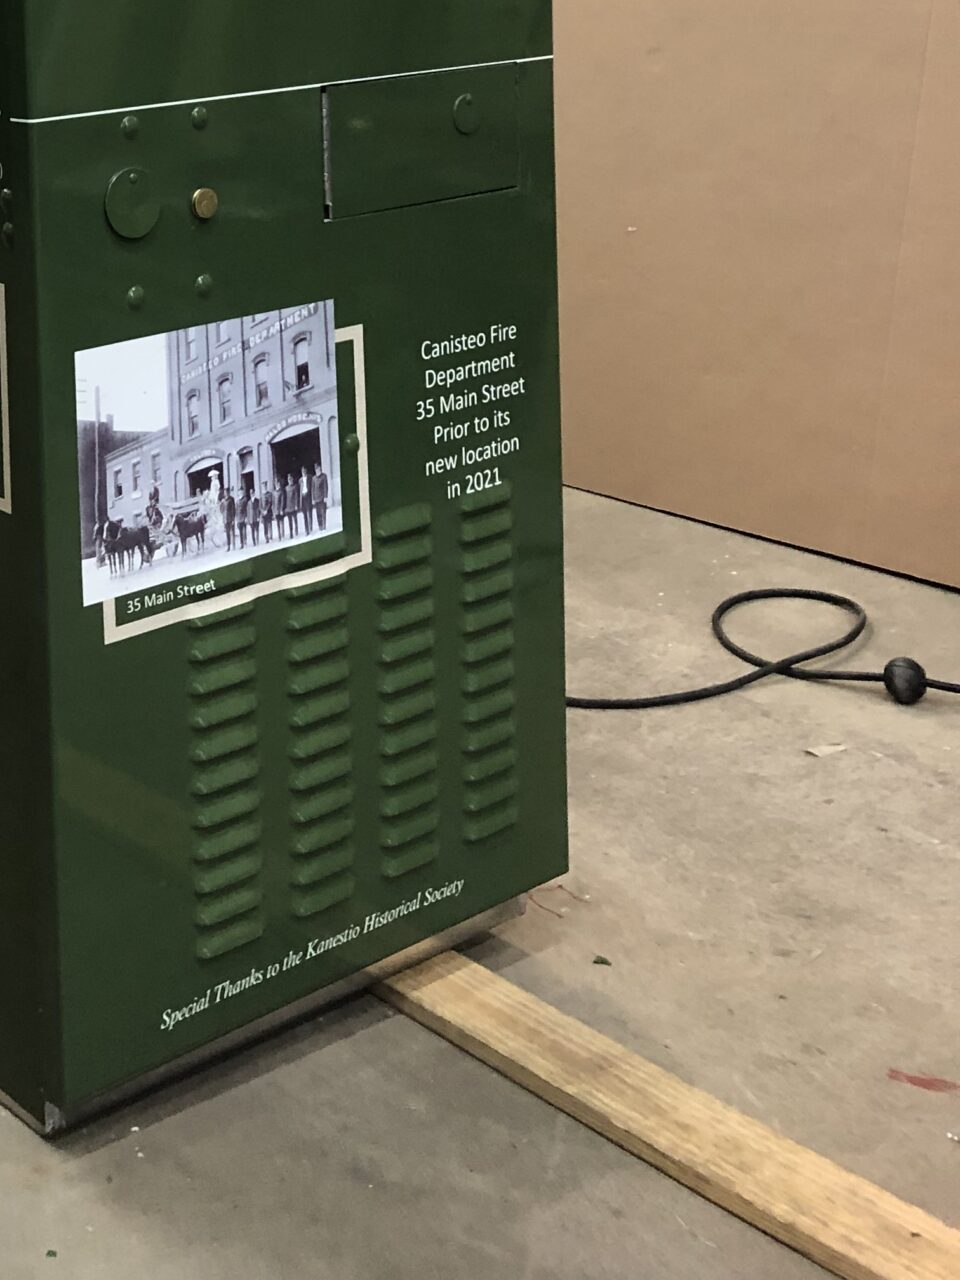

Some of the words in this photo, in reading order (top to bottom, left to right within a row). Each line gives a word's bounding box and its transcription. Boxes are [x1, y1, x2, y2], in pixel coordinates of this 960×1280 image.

[421, 332, 486, 360] Canisteo
[490, 324, 517, 344] Fire
[425, 351, 516, 388] Department
[416, 398, 435, 420] 35
[440, 389, 477, 414] Main
[482, 377, 526, 403] Street
[434, 422, 470, 445] Prior
[474, 416, 490, 434] to
[493, 410, 511, 429] its
[426, 454, 458, 477] new
[461, 437, 520, 467] location
[447, 481, 461, 500] in
[465, 467, 503, 495] 2021
[126, 597, 141, 614] 35
[144, 590, 174, 609] Main
[176, 578, 217, 599] Street
[160, 990, 211, 1031] Special
[214, 968, 264, 1004] Thanks
[266, 961, 280, 979] to
[282, 951, 304, 972] the
[305, 923, 360, 961] Kanestio
[363, 891, 422, 935] Historical
[423, 879, 465, 907] Society
